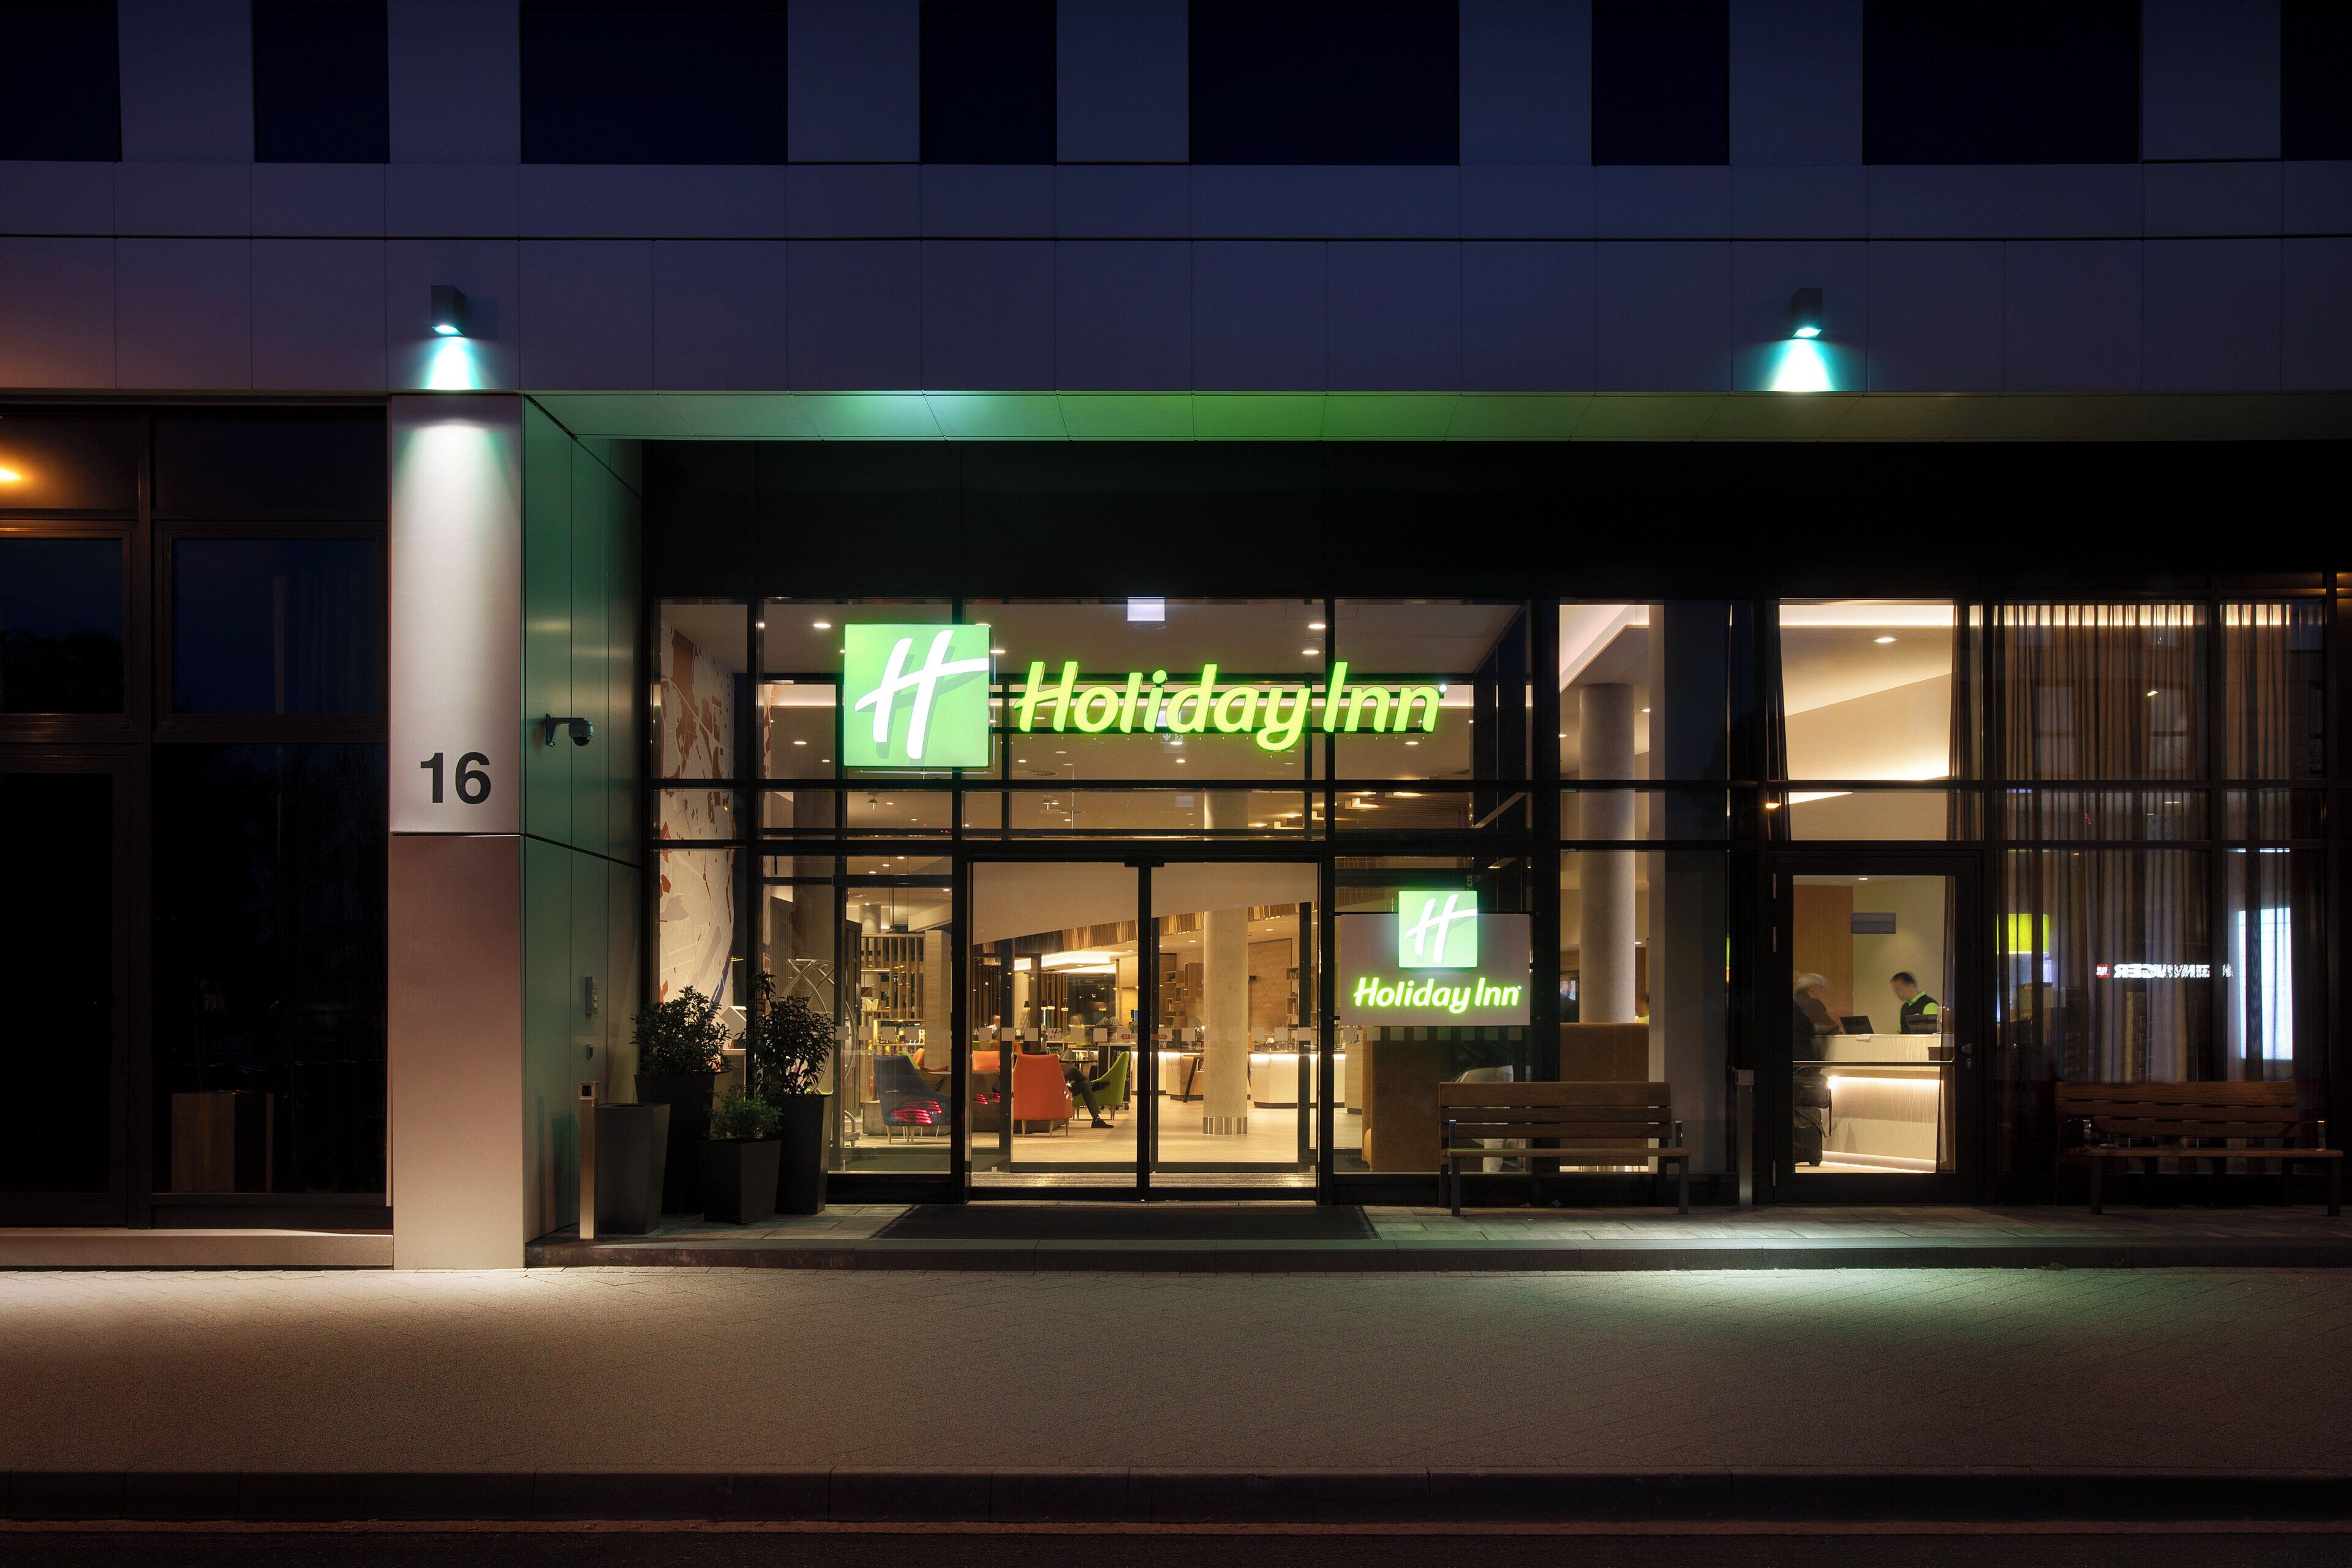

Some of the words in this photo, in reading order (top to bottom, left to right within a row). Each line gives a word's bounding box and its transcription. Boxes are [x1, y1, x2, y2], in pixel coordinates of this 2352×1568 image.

[1014, 661, 1311, 752] Holiday
[1322, 661, 1441, 733] Inn
[420, 752, 491, 805] 16
[1353, 977, 1471, 1014] Holiday
[1474, 977, 1520, 1006] Inn
